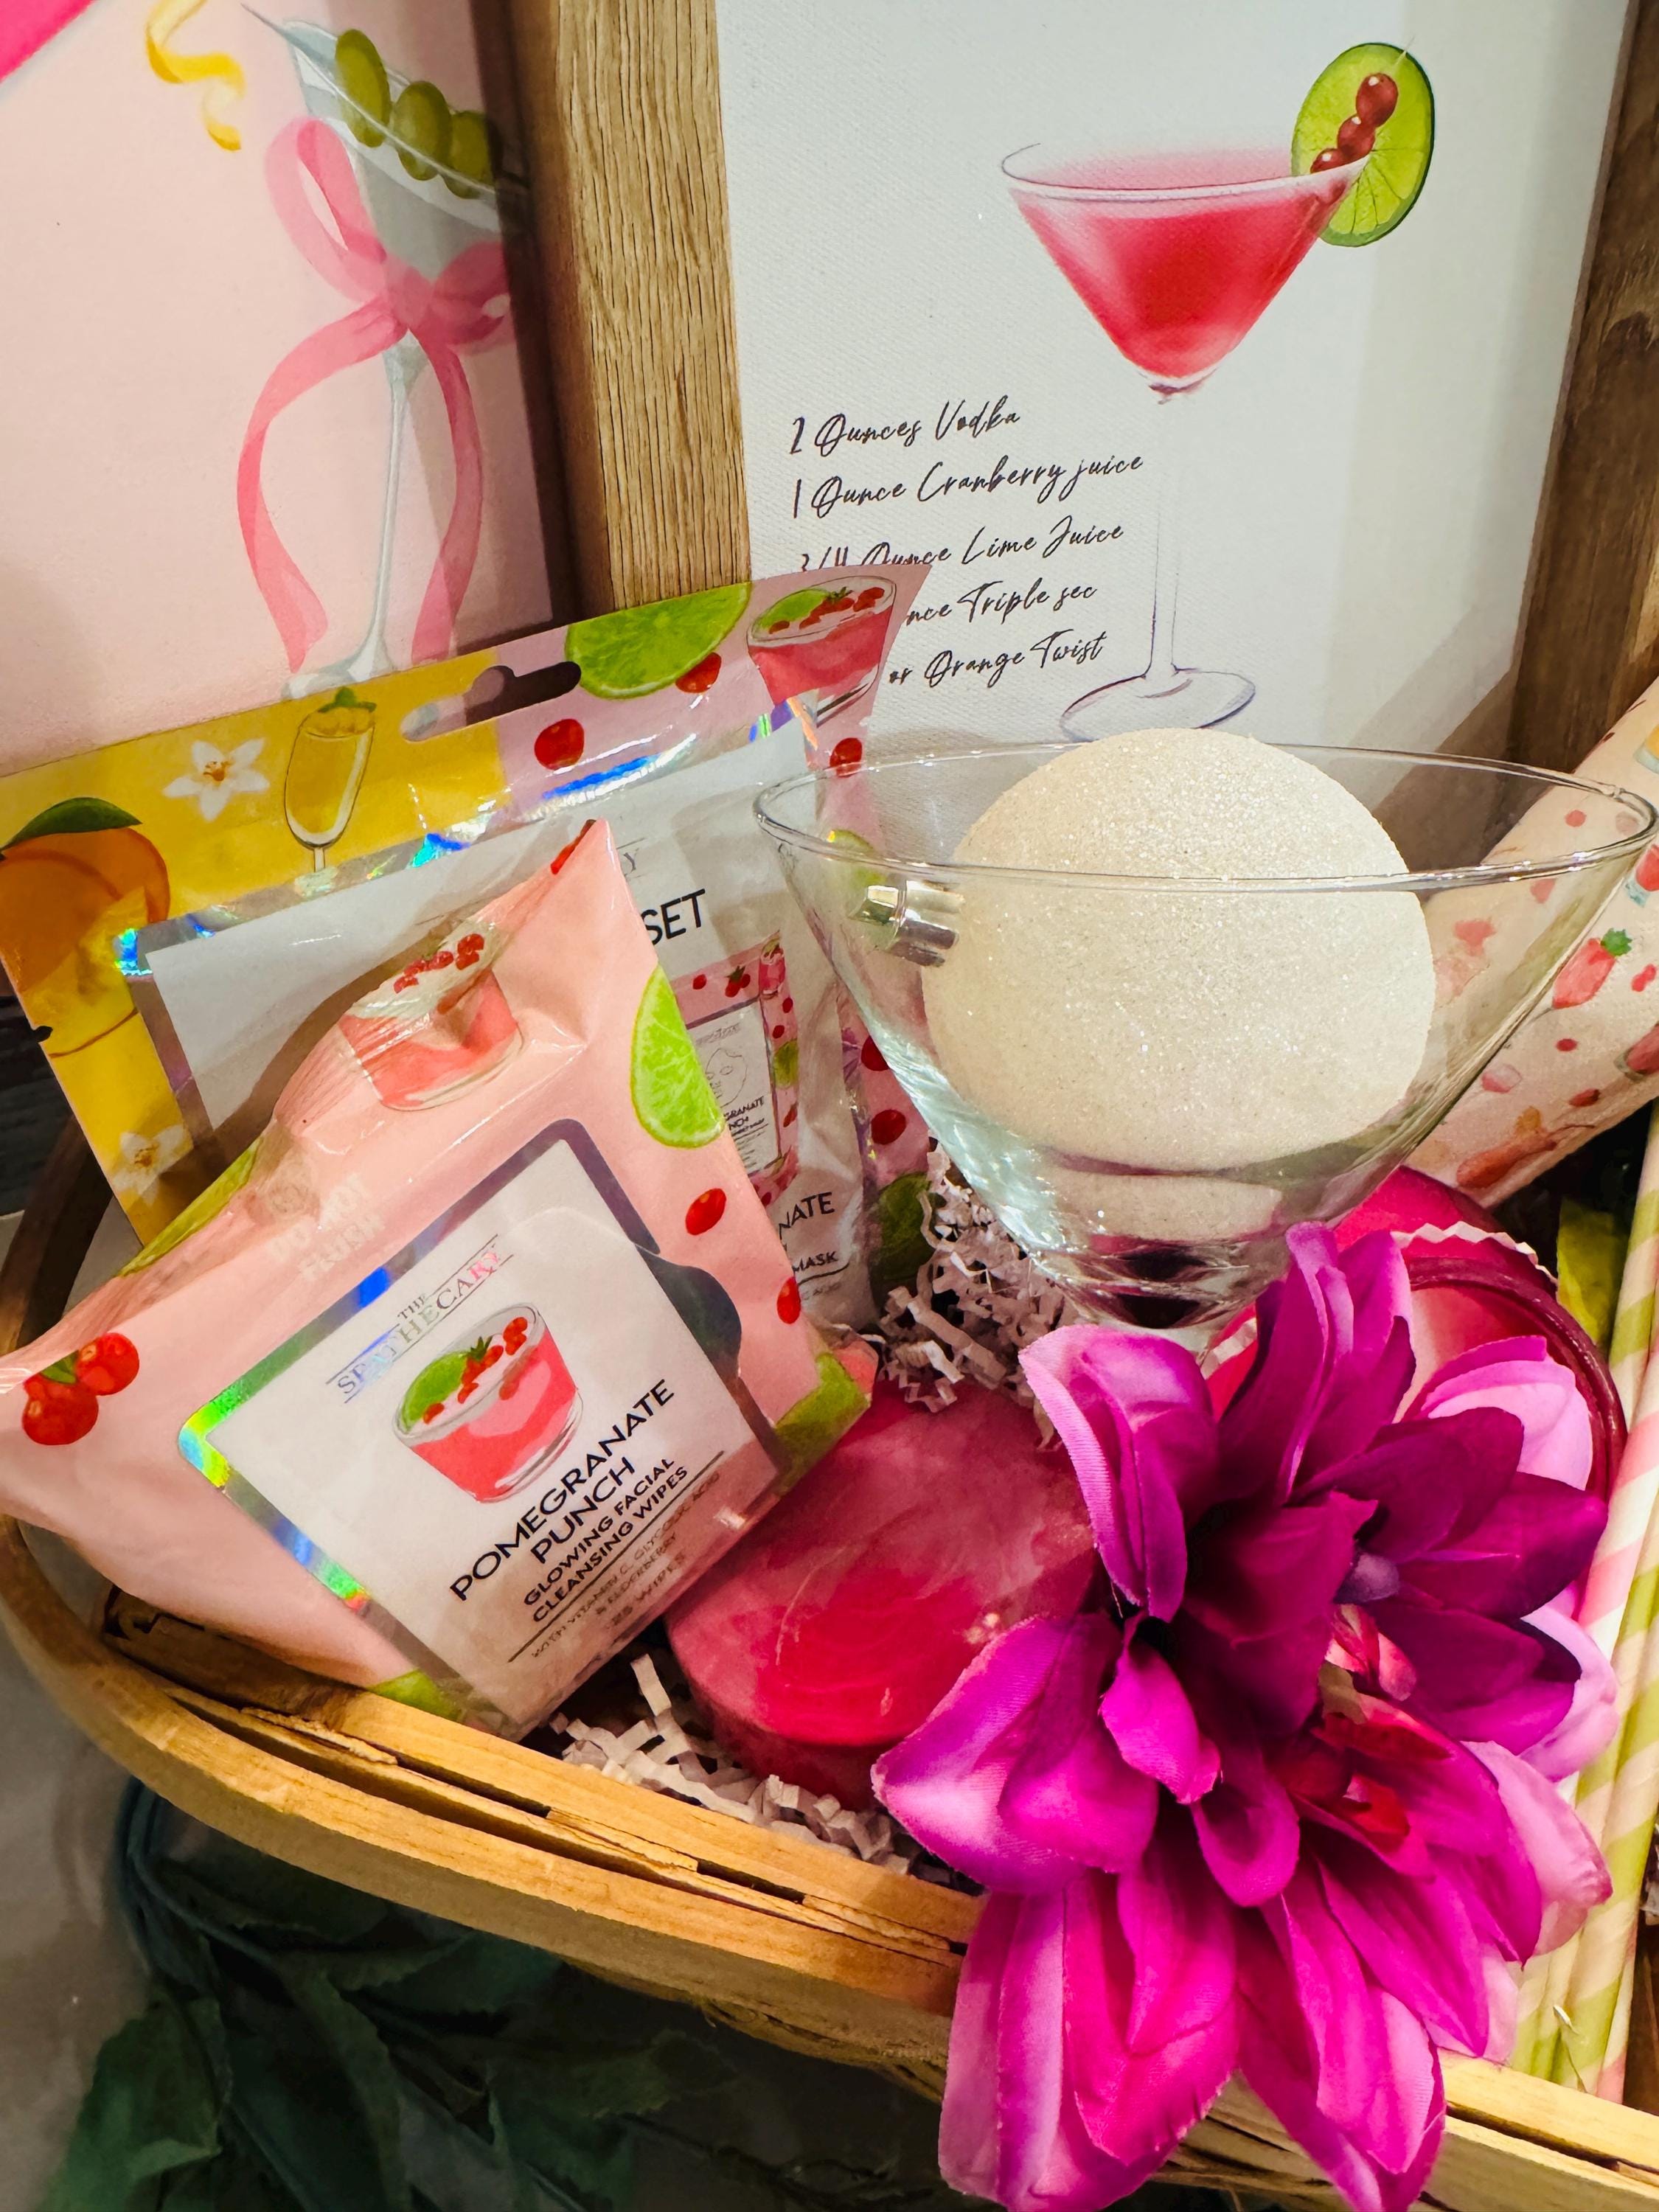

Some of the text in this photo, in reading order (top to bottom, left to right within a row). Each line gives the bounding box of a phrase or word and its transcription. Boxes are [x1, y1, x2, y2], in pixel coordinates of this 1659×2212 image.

[790, 394, 1020, 457] 2 Ounces Vodka
[793, 455, 1144, 519] 1 Ounce Cranberry juice
[961, 526, 1037, 564] Lime
[1043, 515, 1124, 559] Juice
[905, 577, 1098, 626] nce Triple sec
[889, 629, 1107, 688] or Orange Twist
[641, 888, 706, 945] SET
[779, 1192, 835, 1240] NATE
[397, 1293, 428, 1319] THE
[449, 1379, 675, 1601] POMEGRANATE
[531, 1457, 635, 1564] PUNCH
[524, 1458, 675, 1606] GLOWING FACIAL
[532, 1466, 688, 1622] CLEANSING WIPES
